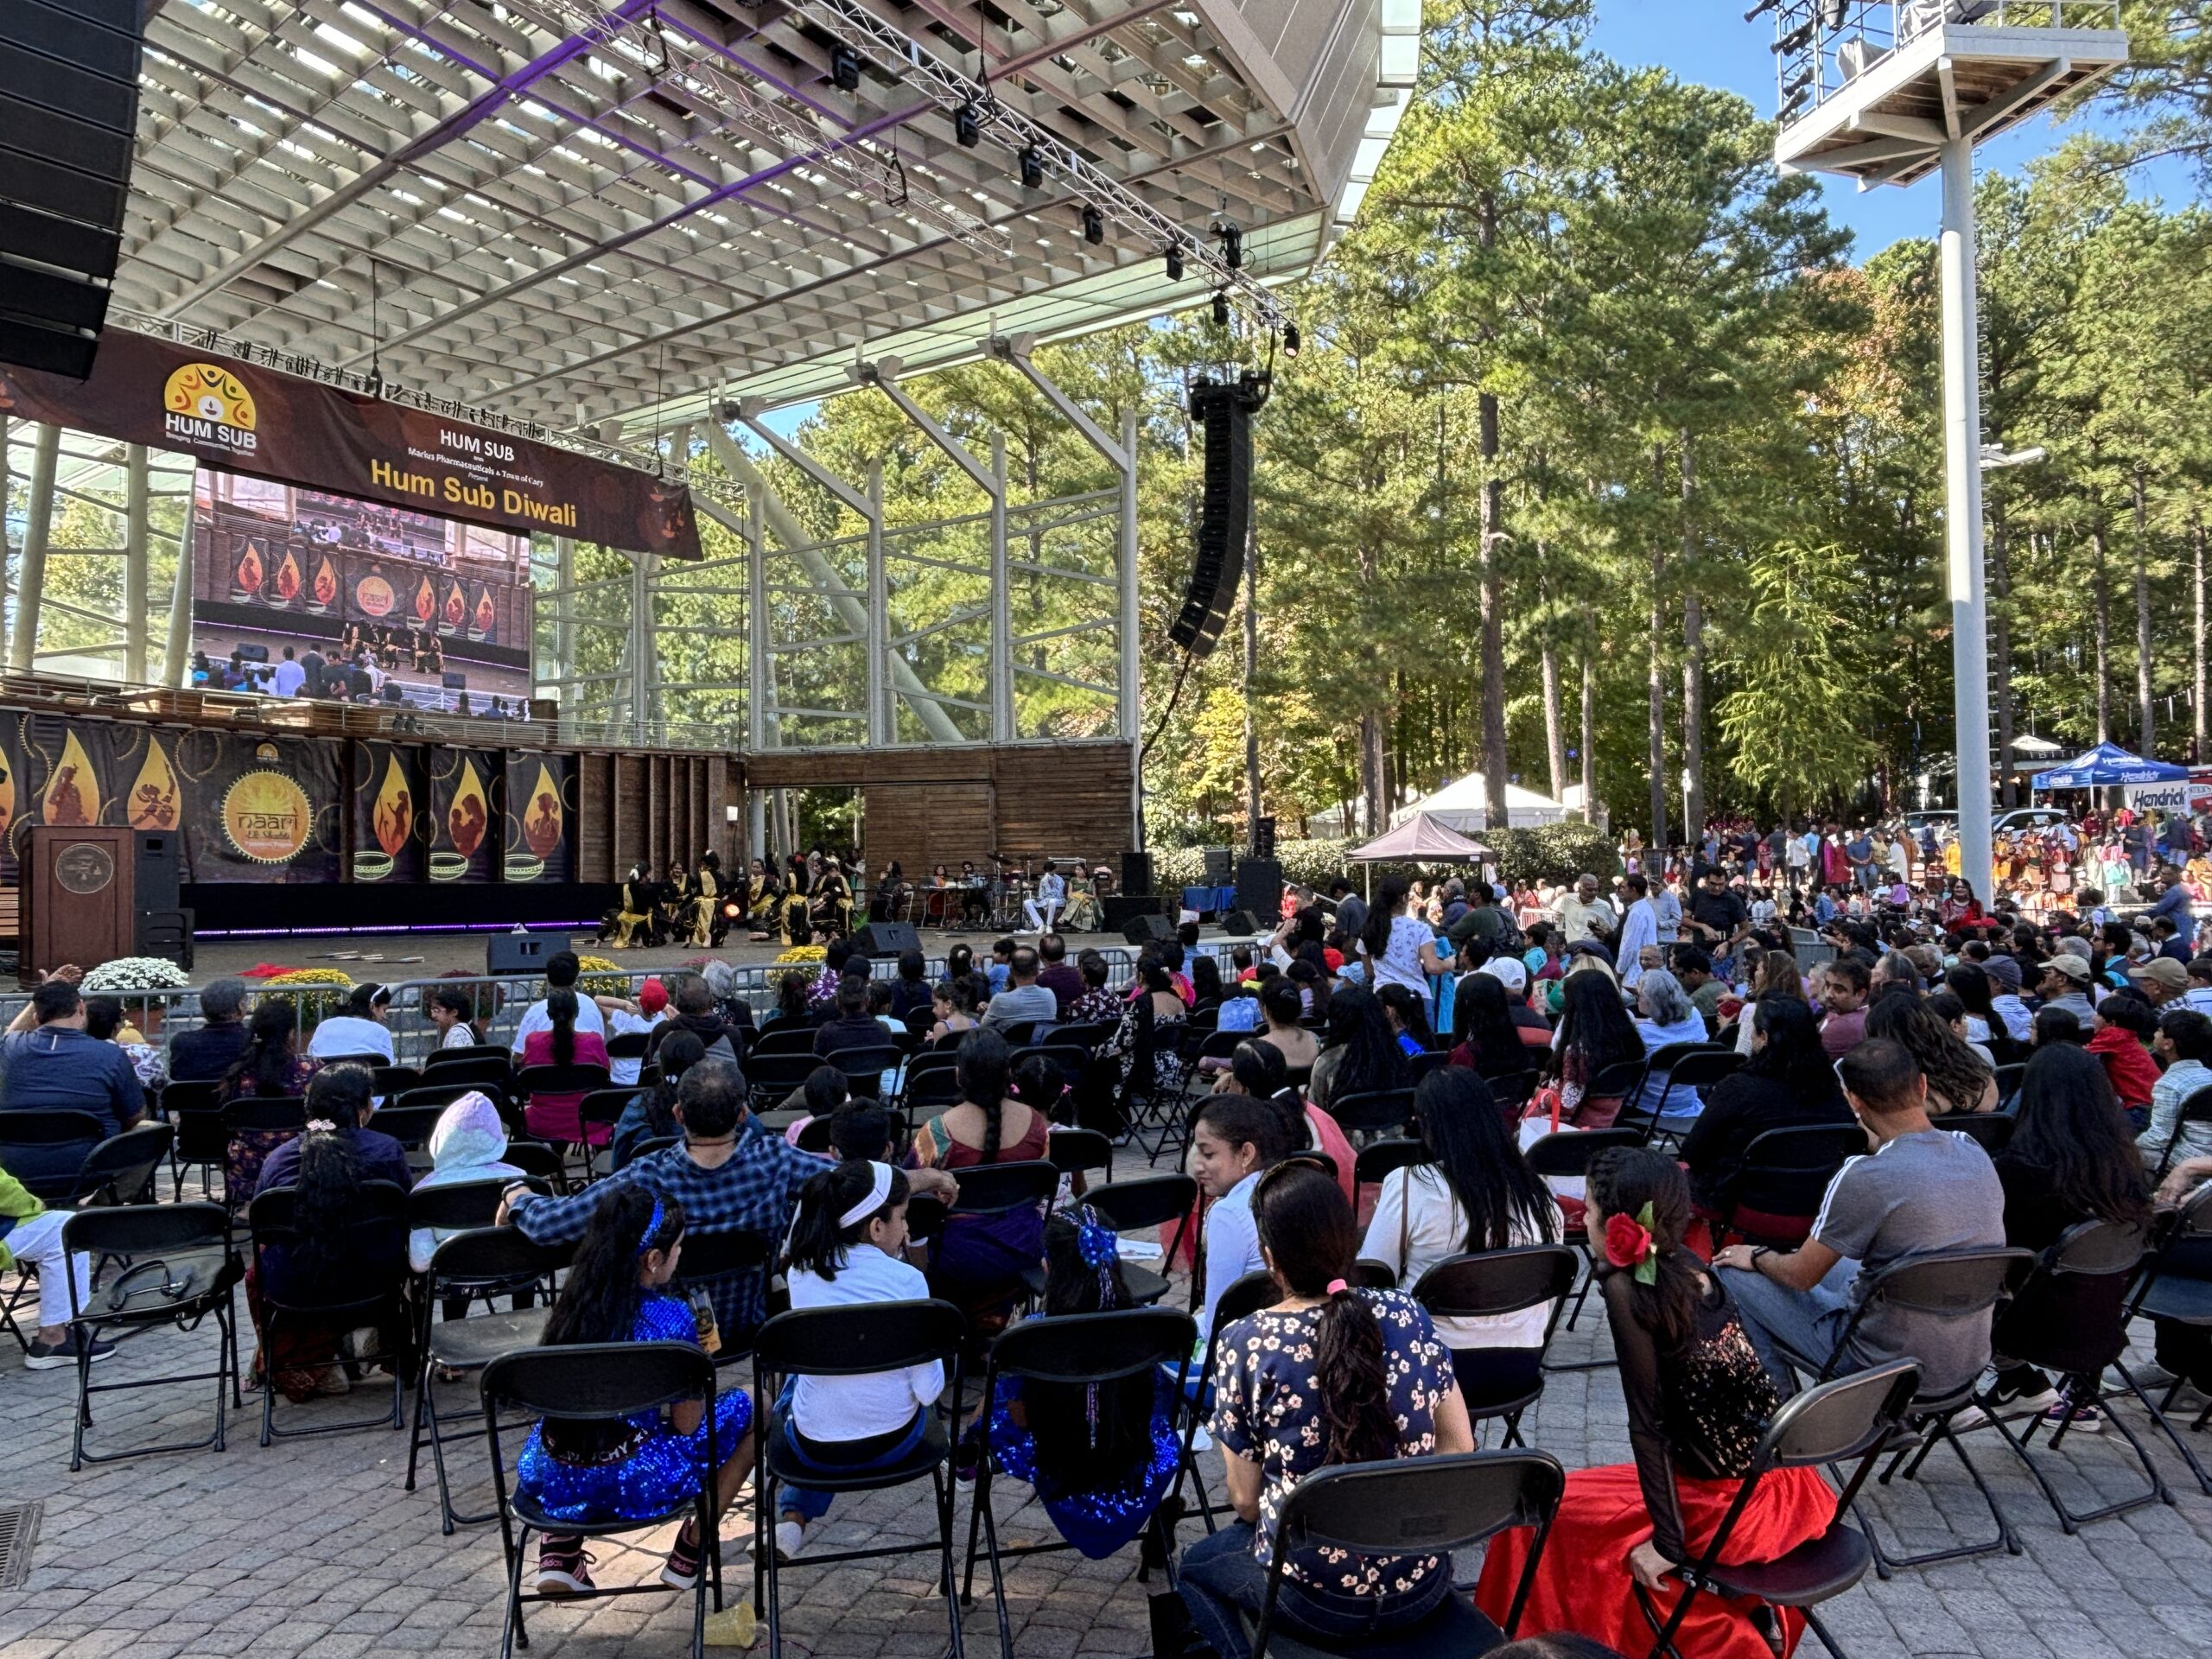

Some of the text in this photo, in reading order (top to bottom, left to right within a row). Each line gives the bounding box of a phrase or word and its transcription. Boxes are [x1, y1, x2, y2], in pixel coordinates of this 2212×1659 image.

[165, 413, 212, 439] HUM
[217, 425, 257, 449] SUB
[440, 429, 515, 461] HUM SUB
[371, 458, 576, 528] Hum Sub Diwali
[501, 470, 520, 481] Town
[528, 477, 544, 488] Cary
